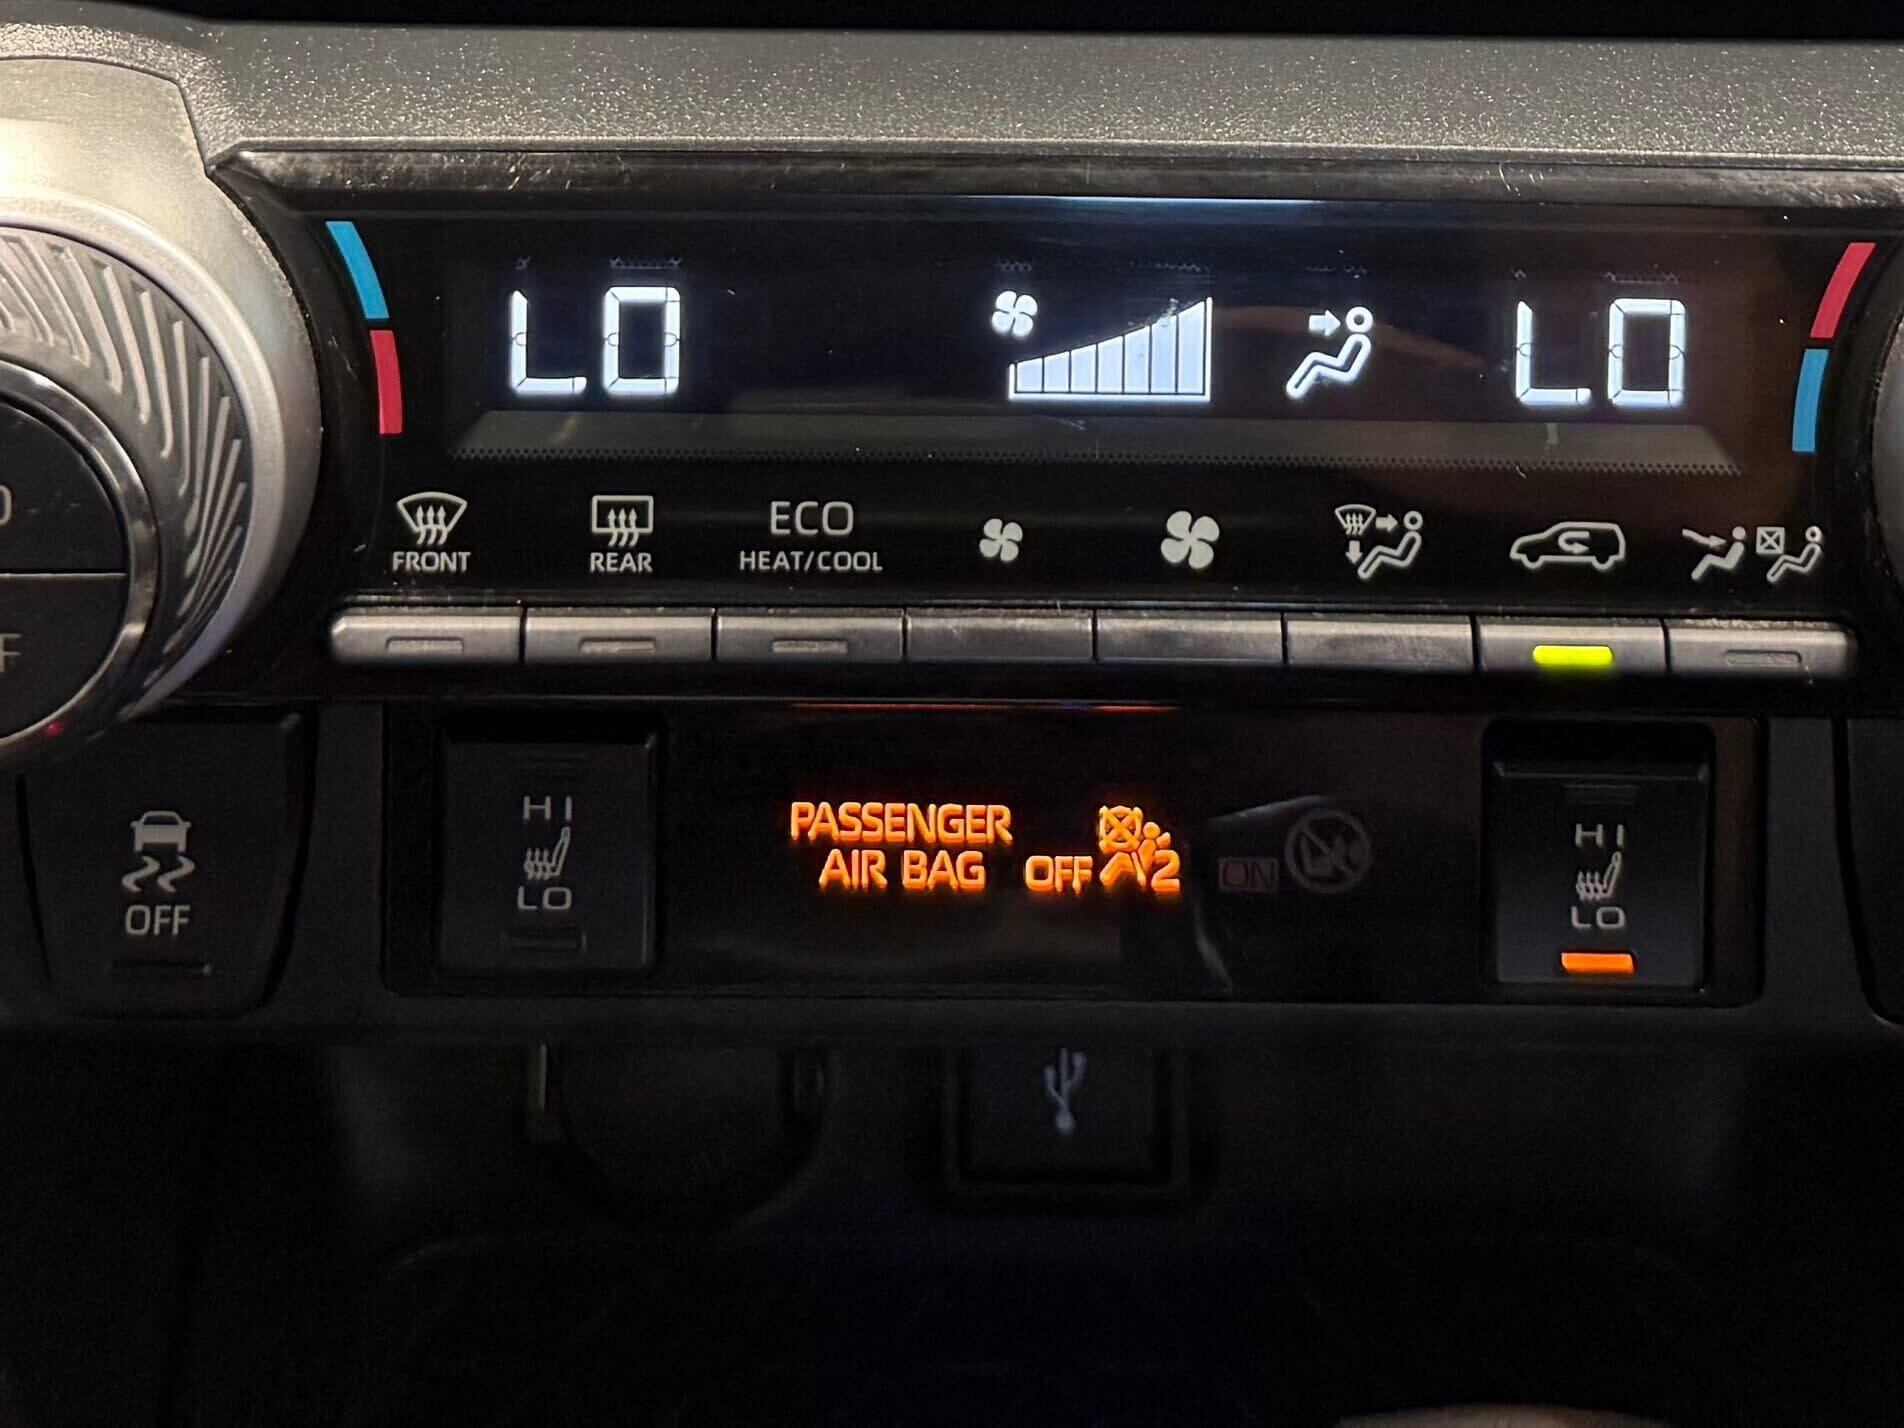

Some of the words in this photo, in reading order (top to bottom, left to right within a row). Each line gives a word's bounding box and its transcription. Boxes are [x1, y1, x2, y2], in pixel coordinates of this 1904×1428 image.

[508, 284, 683, 398] LO
[1514, 296, 1687, 409] LO
[769, 500, 855, 537] ECO
[391, 550, 472, 574] FRONT
[589, 550, 654, 574] REAR
[738, 550, 884, 575] HEAT/COOL
[522, 794, 574, 824] HI
[789, 800, 1014, 847] PASSENGER
[1574, 822, 1626, 849] HI
[818, 847, 888, 893] AIR
[900, 848, 988, 894] BAG
[1025, 854, 1094, 895] OFF
[516, 885, 573, 912] LO
[124, 904, 192, 936] OFF
[1570, 904, 1627, 931] LO
